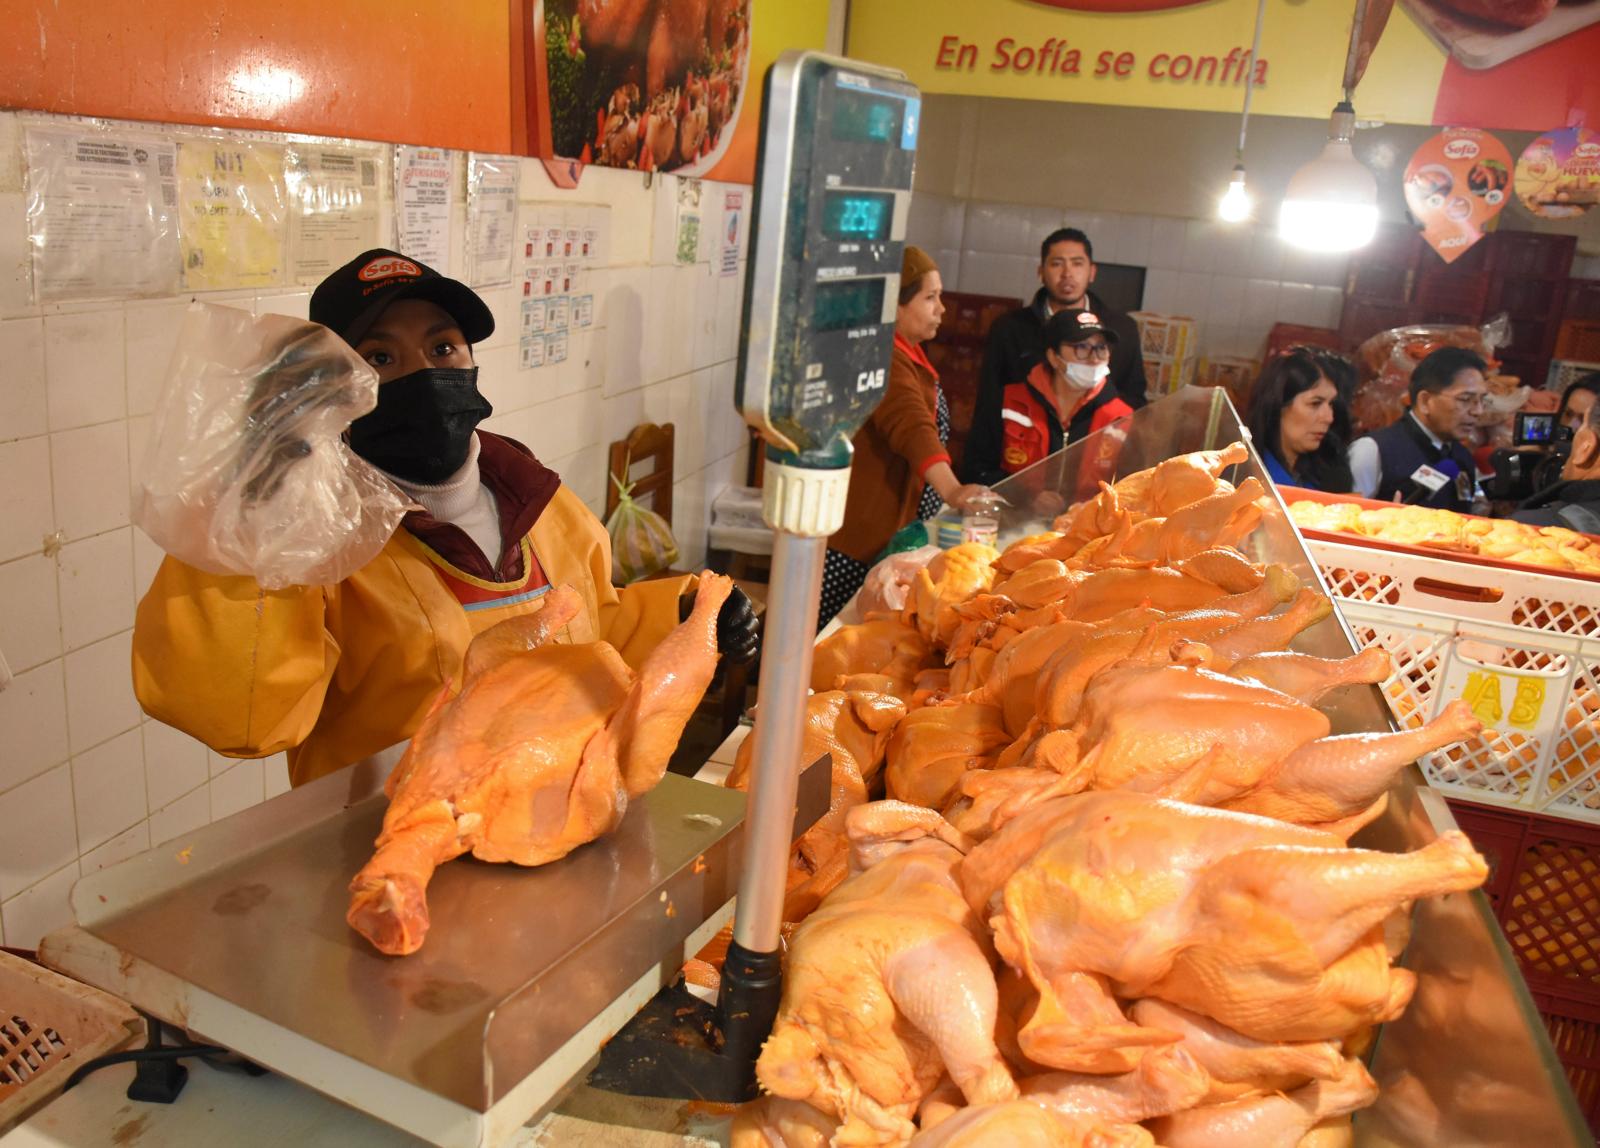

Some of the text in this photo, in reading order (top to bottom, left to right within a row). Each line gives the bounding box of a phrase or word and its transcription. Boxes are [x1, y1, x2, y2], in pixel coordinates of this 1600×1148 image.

[935, 36, 1269, 85] En Sofía se confía
[857, 368, 885, 393] CAS
